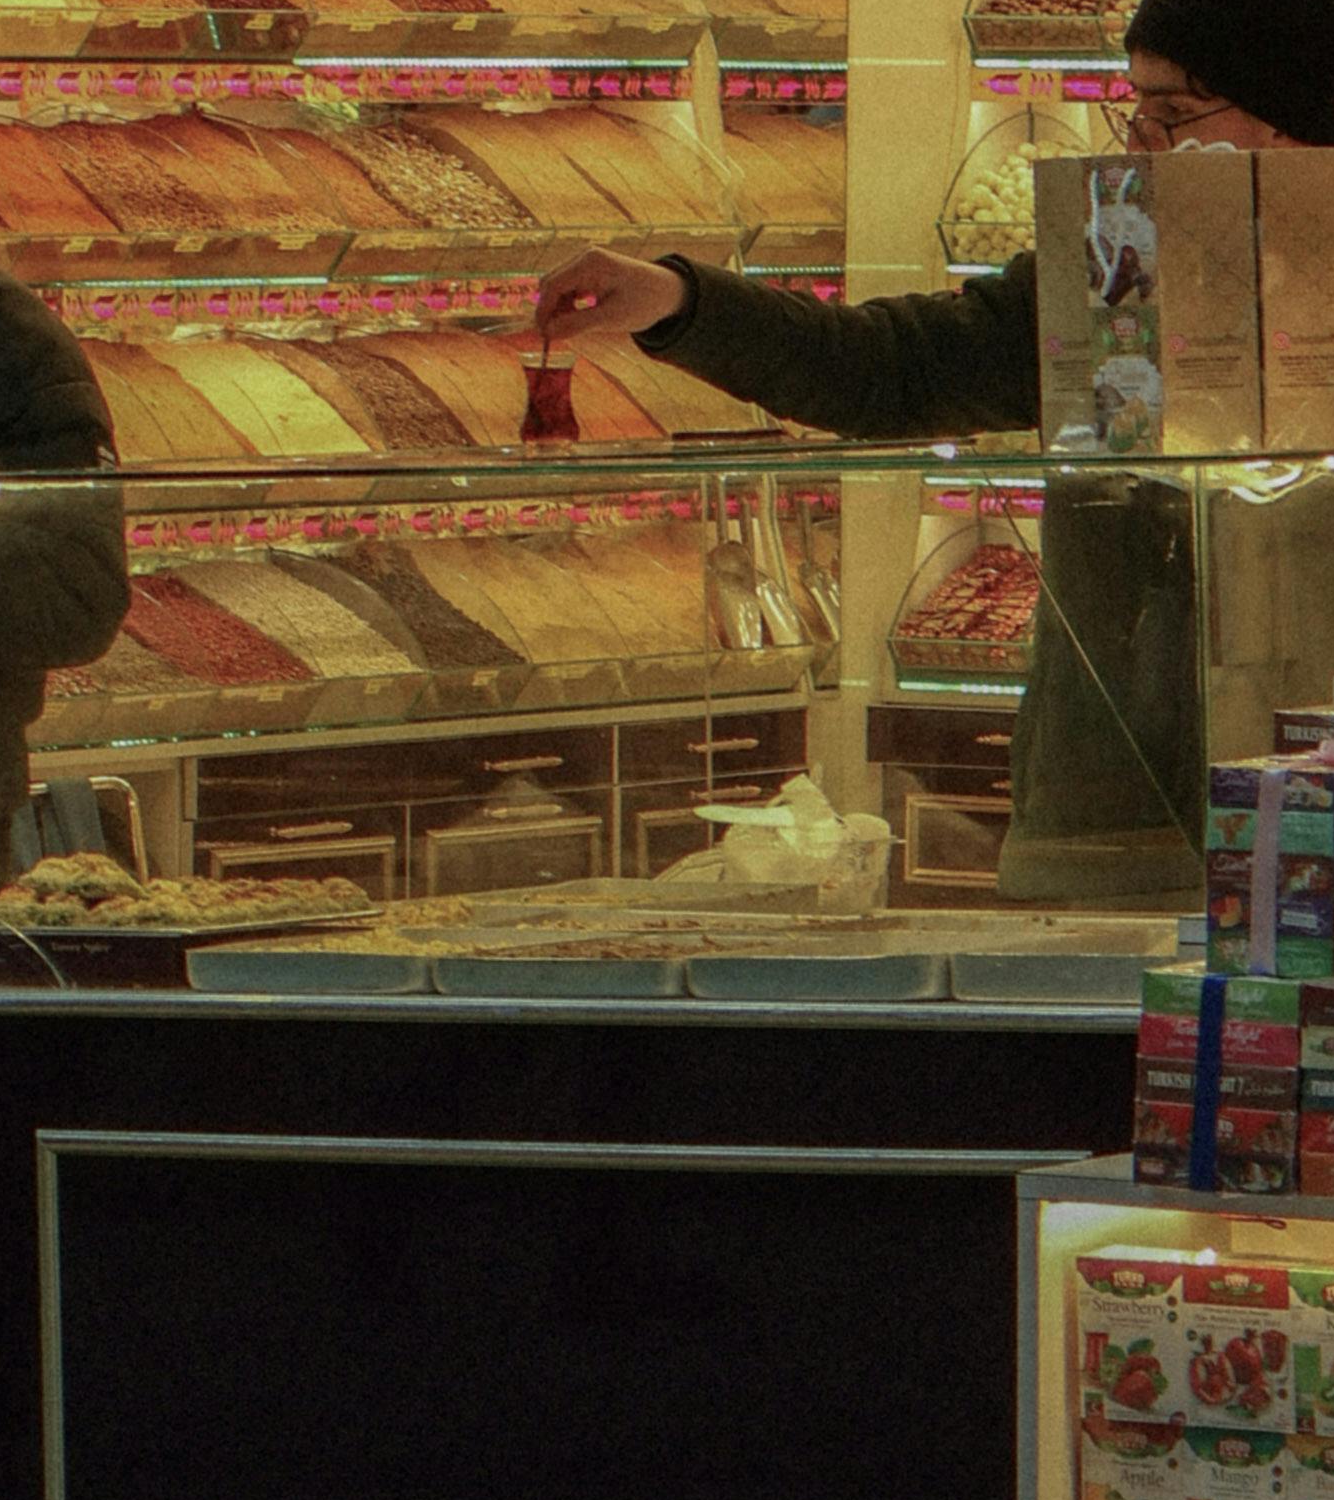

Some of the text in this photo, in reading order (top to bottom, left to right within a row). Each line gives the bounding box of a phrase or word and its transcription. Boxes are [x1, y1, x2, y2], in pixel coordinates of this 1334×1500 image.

[1092, 1298, 1166, 1319] Strawberry
[1120, 1468, 1165, 1488] Apple
[1210, 1466, 1260, 1488] Mango
